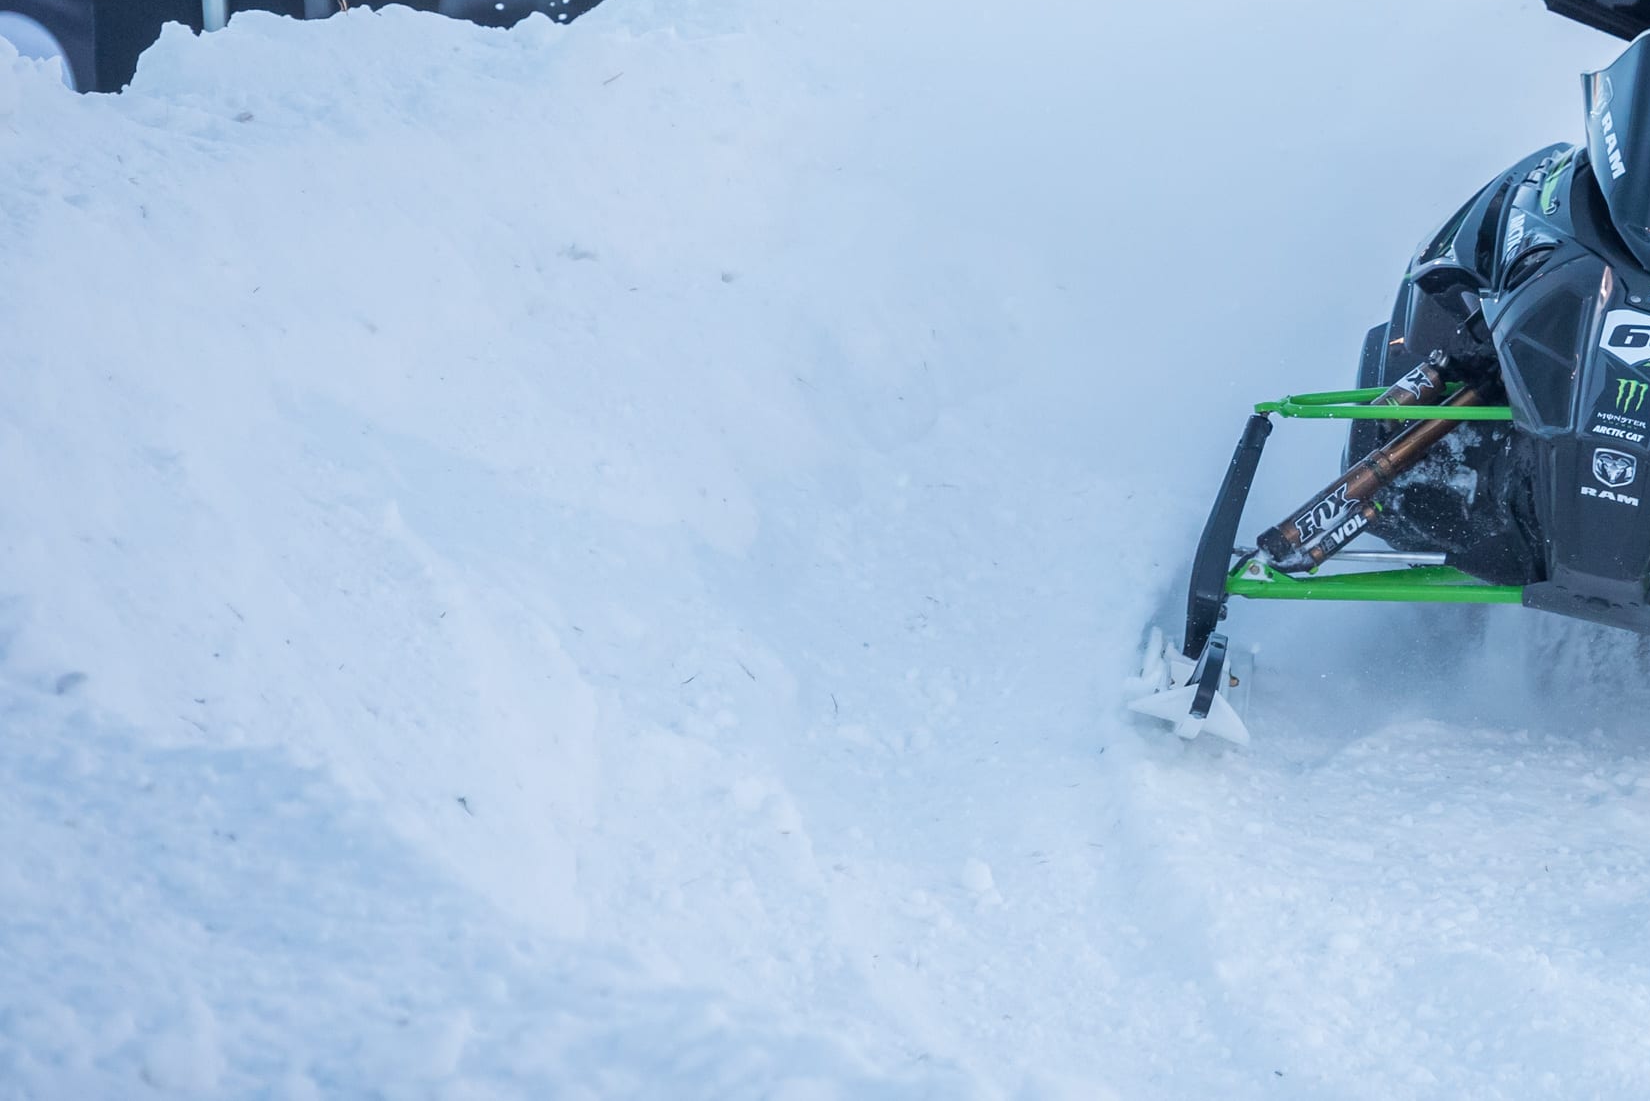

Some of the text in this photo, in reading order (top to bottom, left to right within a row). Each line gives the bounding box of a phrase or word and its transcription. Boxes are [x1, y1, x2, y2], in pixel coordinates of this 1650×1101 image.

[1602, 110, 1627, 180] RAM
[1597, 411, 1646, 429] MONSTER
[1592, 424, 1627, 438] ARCTIC
[1625, 432, 1645, 443] CAT
[1581, 486, 1640, 507] RAM
[1294, 482, 1360, 543] FOX
